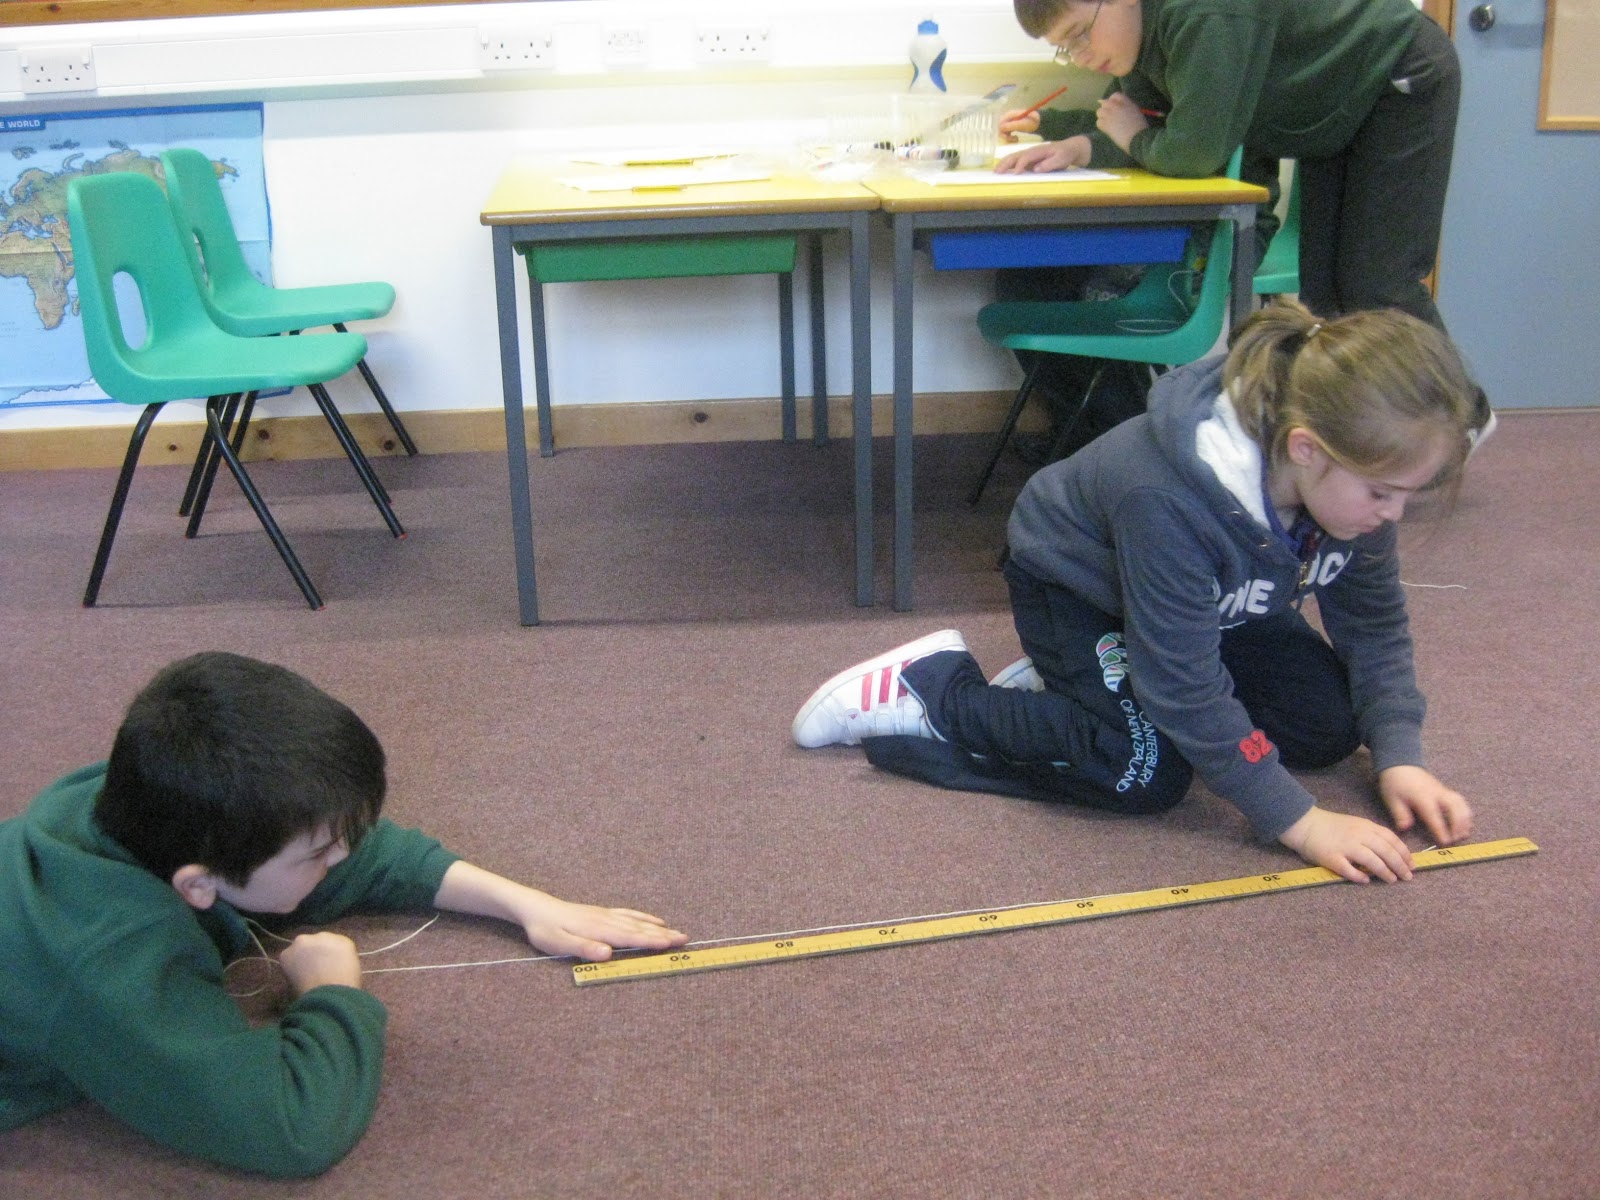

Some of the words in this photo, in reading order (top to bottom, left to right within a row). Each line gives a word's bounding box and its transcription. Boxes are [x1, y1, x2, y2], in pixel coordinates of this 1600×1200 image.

[7, 120, 40, 128] WORLD
[1120, 699, 1135, 714] OF
[1126, 715, 1143, 740] NEW
[1138, 711, 1158, 788] CANTERBURY
[1116, 740, 1145, 792] ZEALAND
[1262, 874, 1281, 882] 30
[1076, 901, 1094, 909] 50
[978, 914, 998, 922] 60
[878, 928, 899, 936] 70
[775, 941, 794, 949] 80
[669, 954, 690, 962] 90
[574, 965, 599, 973] 100
